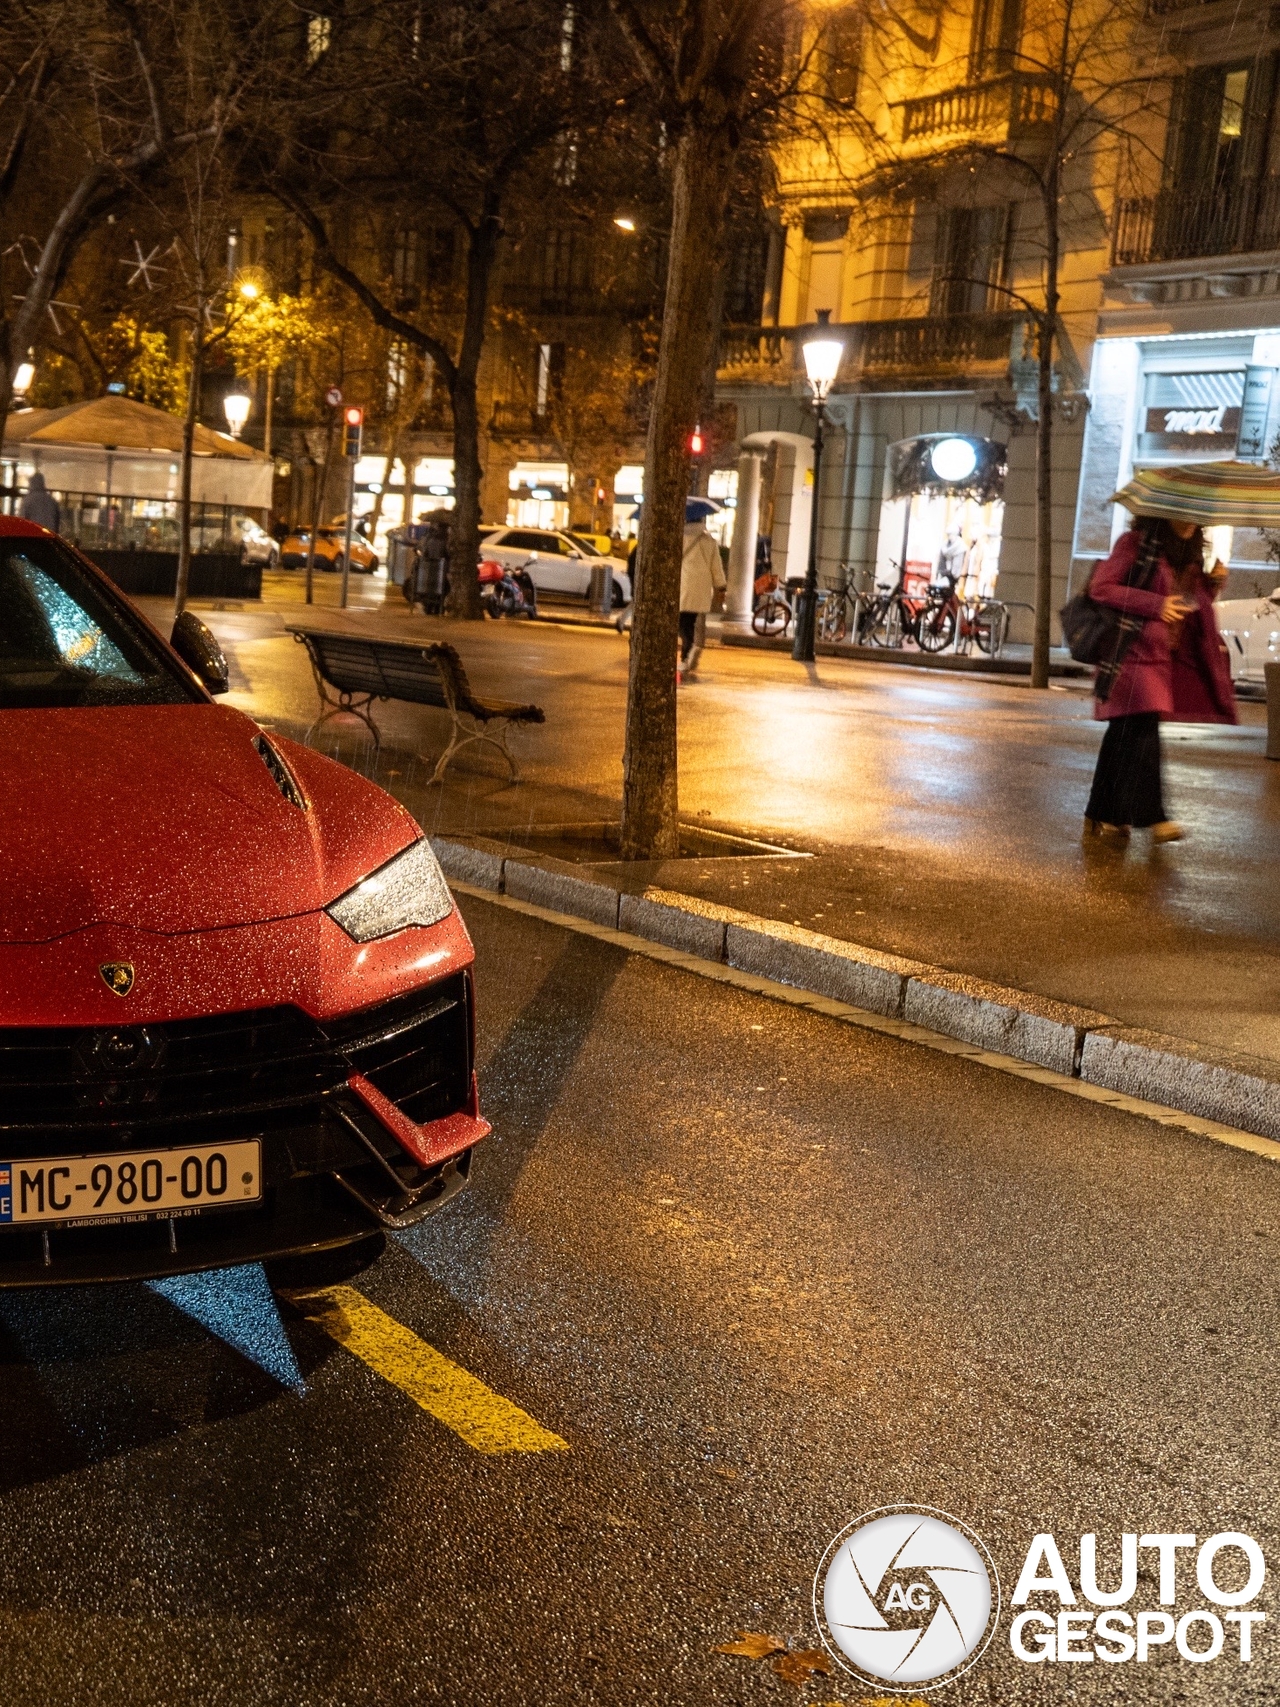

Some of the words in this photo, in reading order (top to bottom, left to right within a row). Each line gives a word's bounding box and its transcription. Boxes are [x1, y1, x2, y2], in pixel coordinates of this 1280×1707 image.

[20, 1152, 228, 1213] MC-980-00
[67, 1216, 121, 1228] LAMBORGHINI
[122, 1214, 148, 1224] TBILISI
[156, 1212, 169, 1220] 032
[170, 1210, 182, 1219] 224
[194, 1208, 201, 1216] 11
